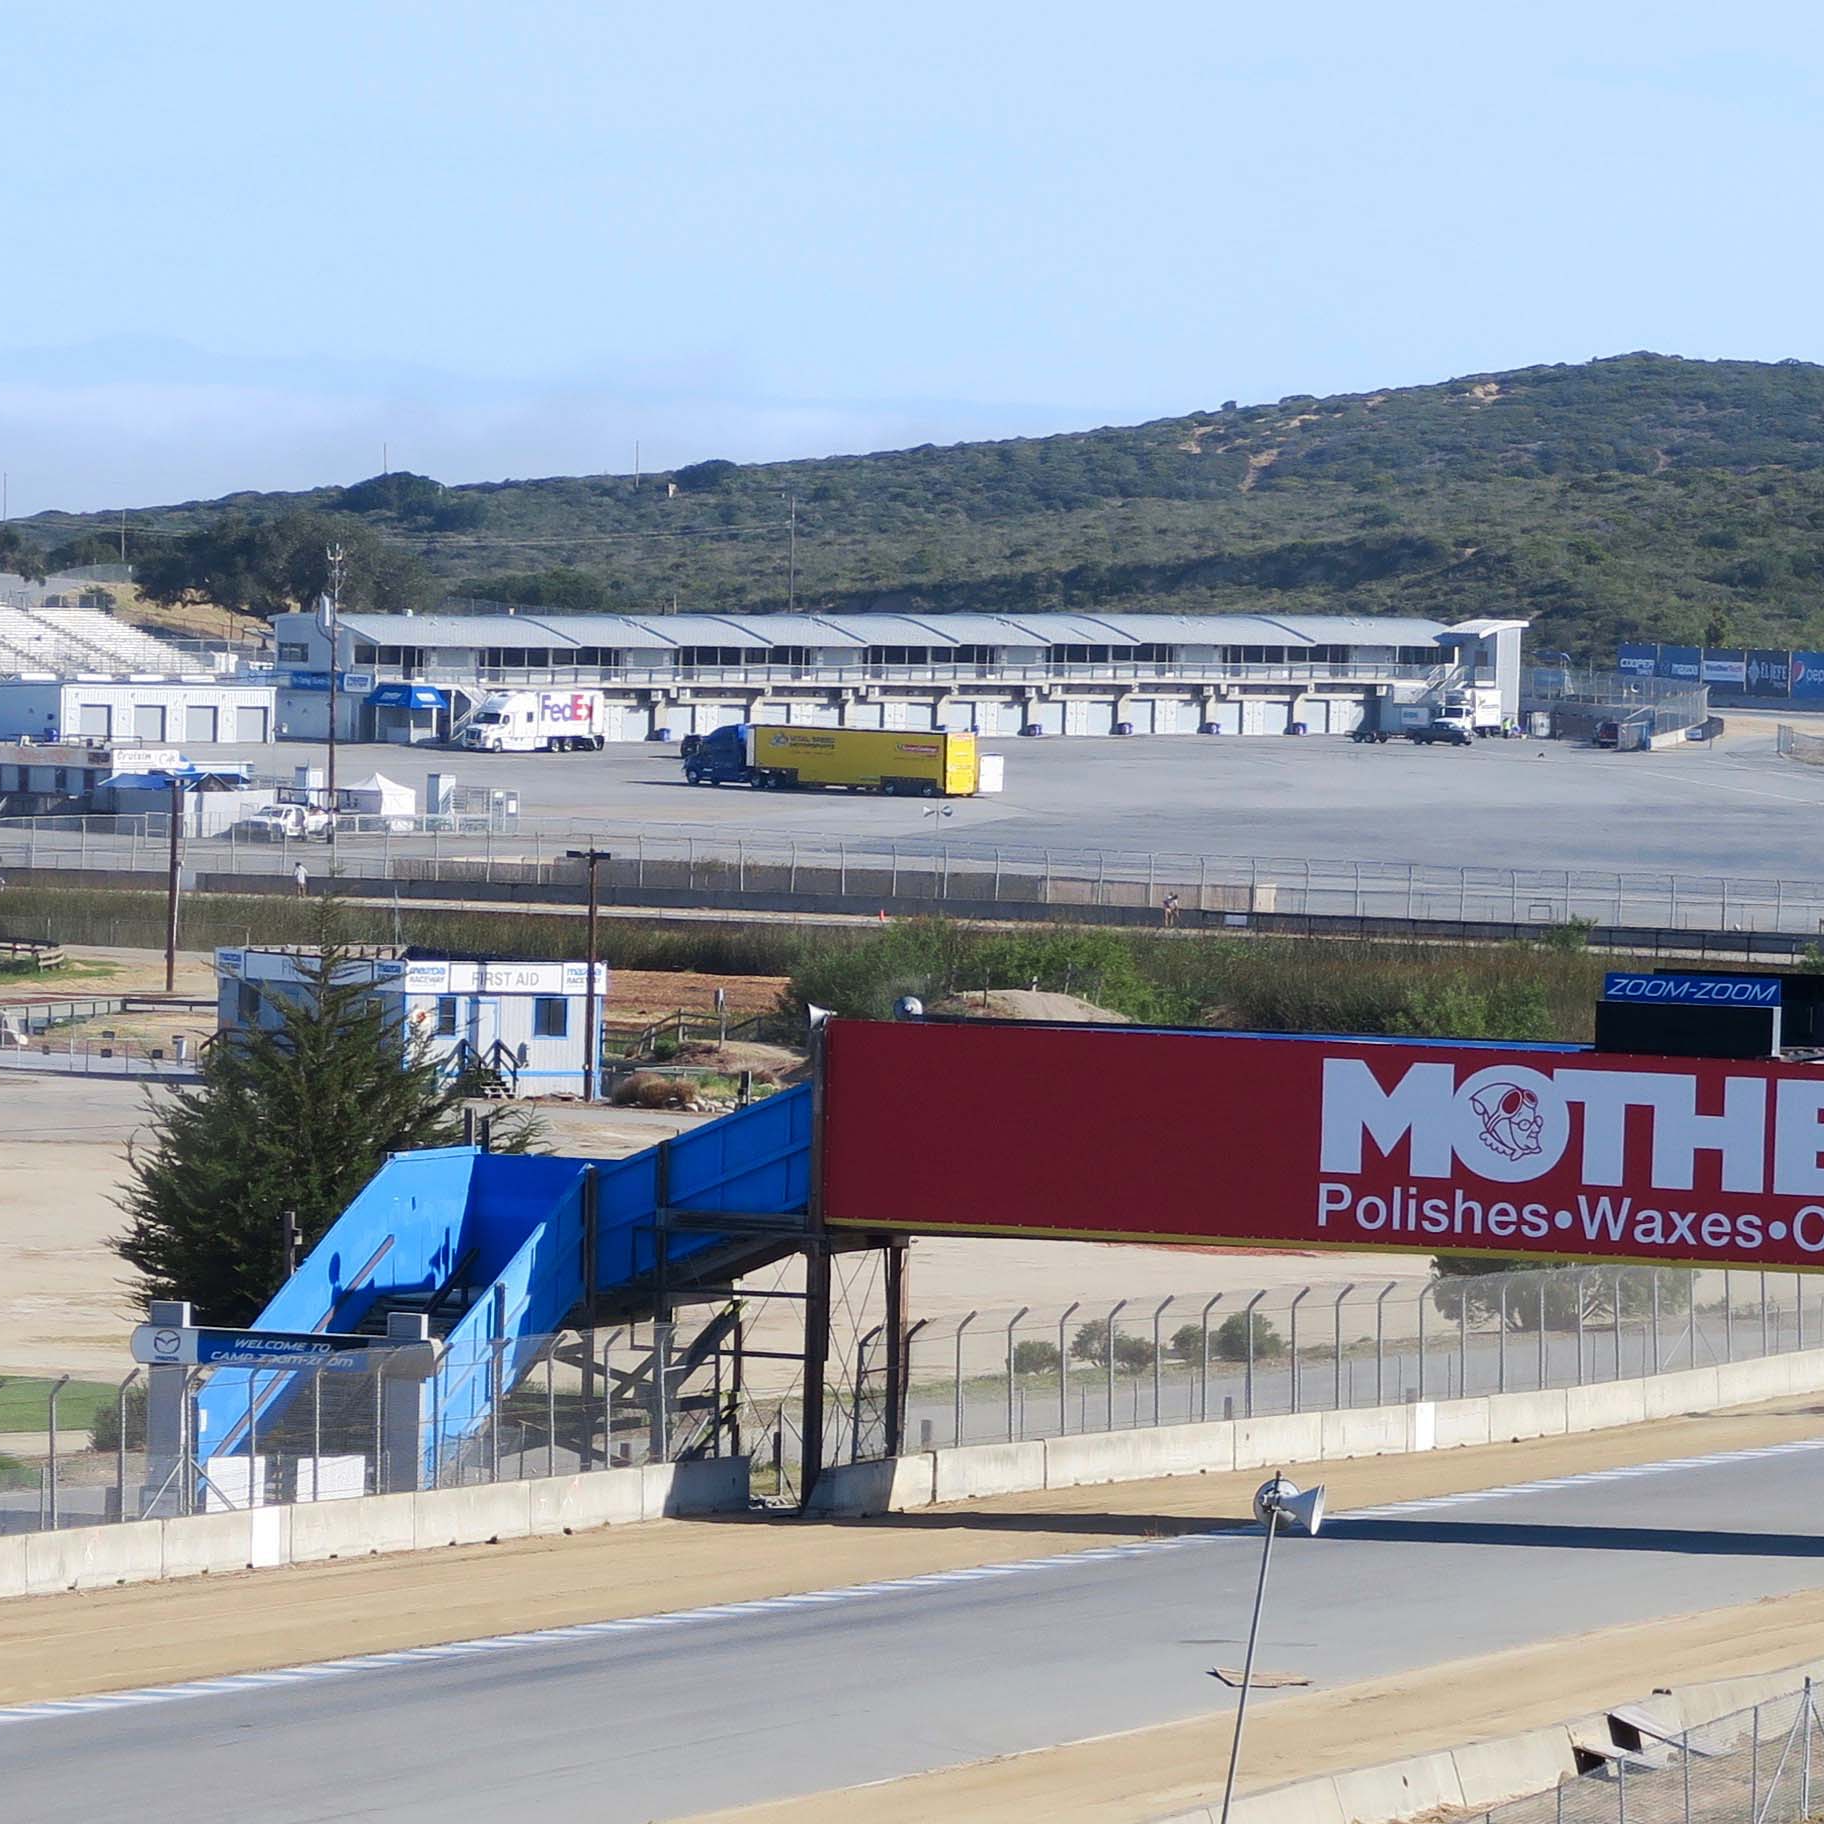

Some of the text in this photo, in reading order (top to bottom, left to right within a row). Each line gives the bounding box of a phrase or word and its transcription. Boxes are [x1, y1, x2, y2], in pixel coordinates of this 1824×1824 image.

[541, 694, 593, 722] FedEx
[472, 971, 540, 986] FIRST AID
[1607, 978, 1778, 1001] ZOOM-ZOOM
[234, 1338, 307, 1352] WELCOME
[210, 1350, 253, 1361] CAMP
